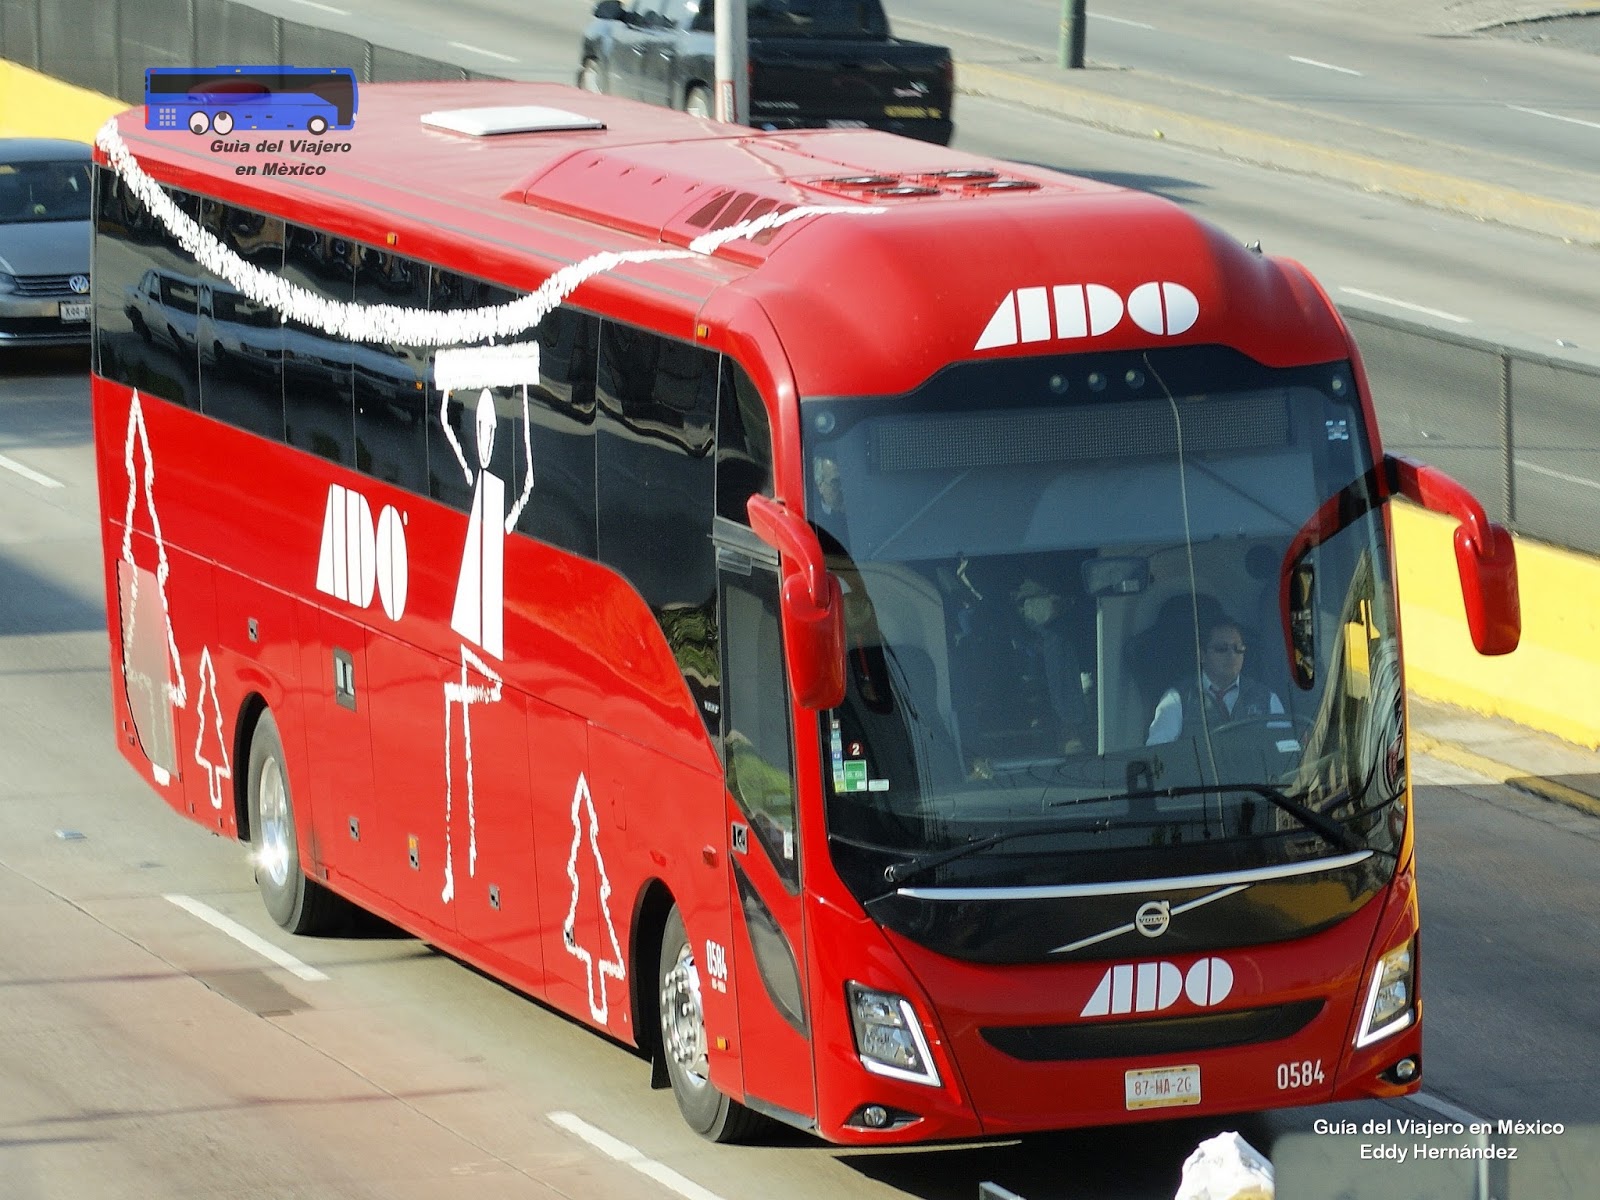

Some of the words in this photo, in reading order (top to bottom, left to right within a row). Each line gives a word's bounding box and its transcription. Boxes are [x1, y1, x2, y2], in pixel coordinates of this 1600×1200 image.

[973, 281, 1200, 351] ADO
[315, 482, 409, 622] ADO
[851, 742, 861, 756] 2
[1138, 915, 1168, 924] VOLVO
[706, 939, 728, 982] 0584
[1079, 957, 1234, 1018] ADO
[1277, 1059, 1325, 1090] 0584
